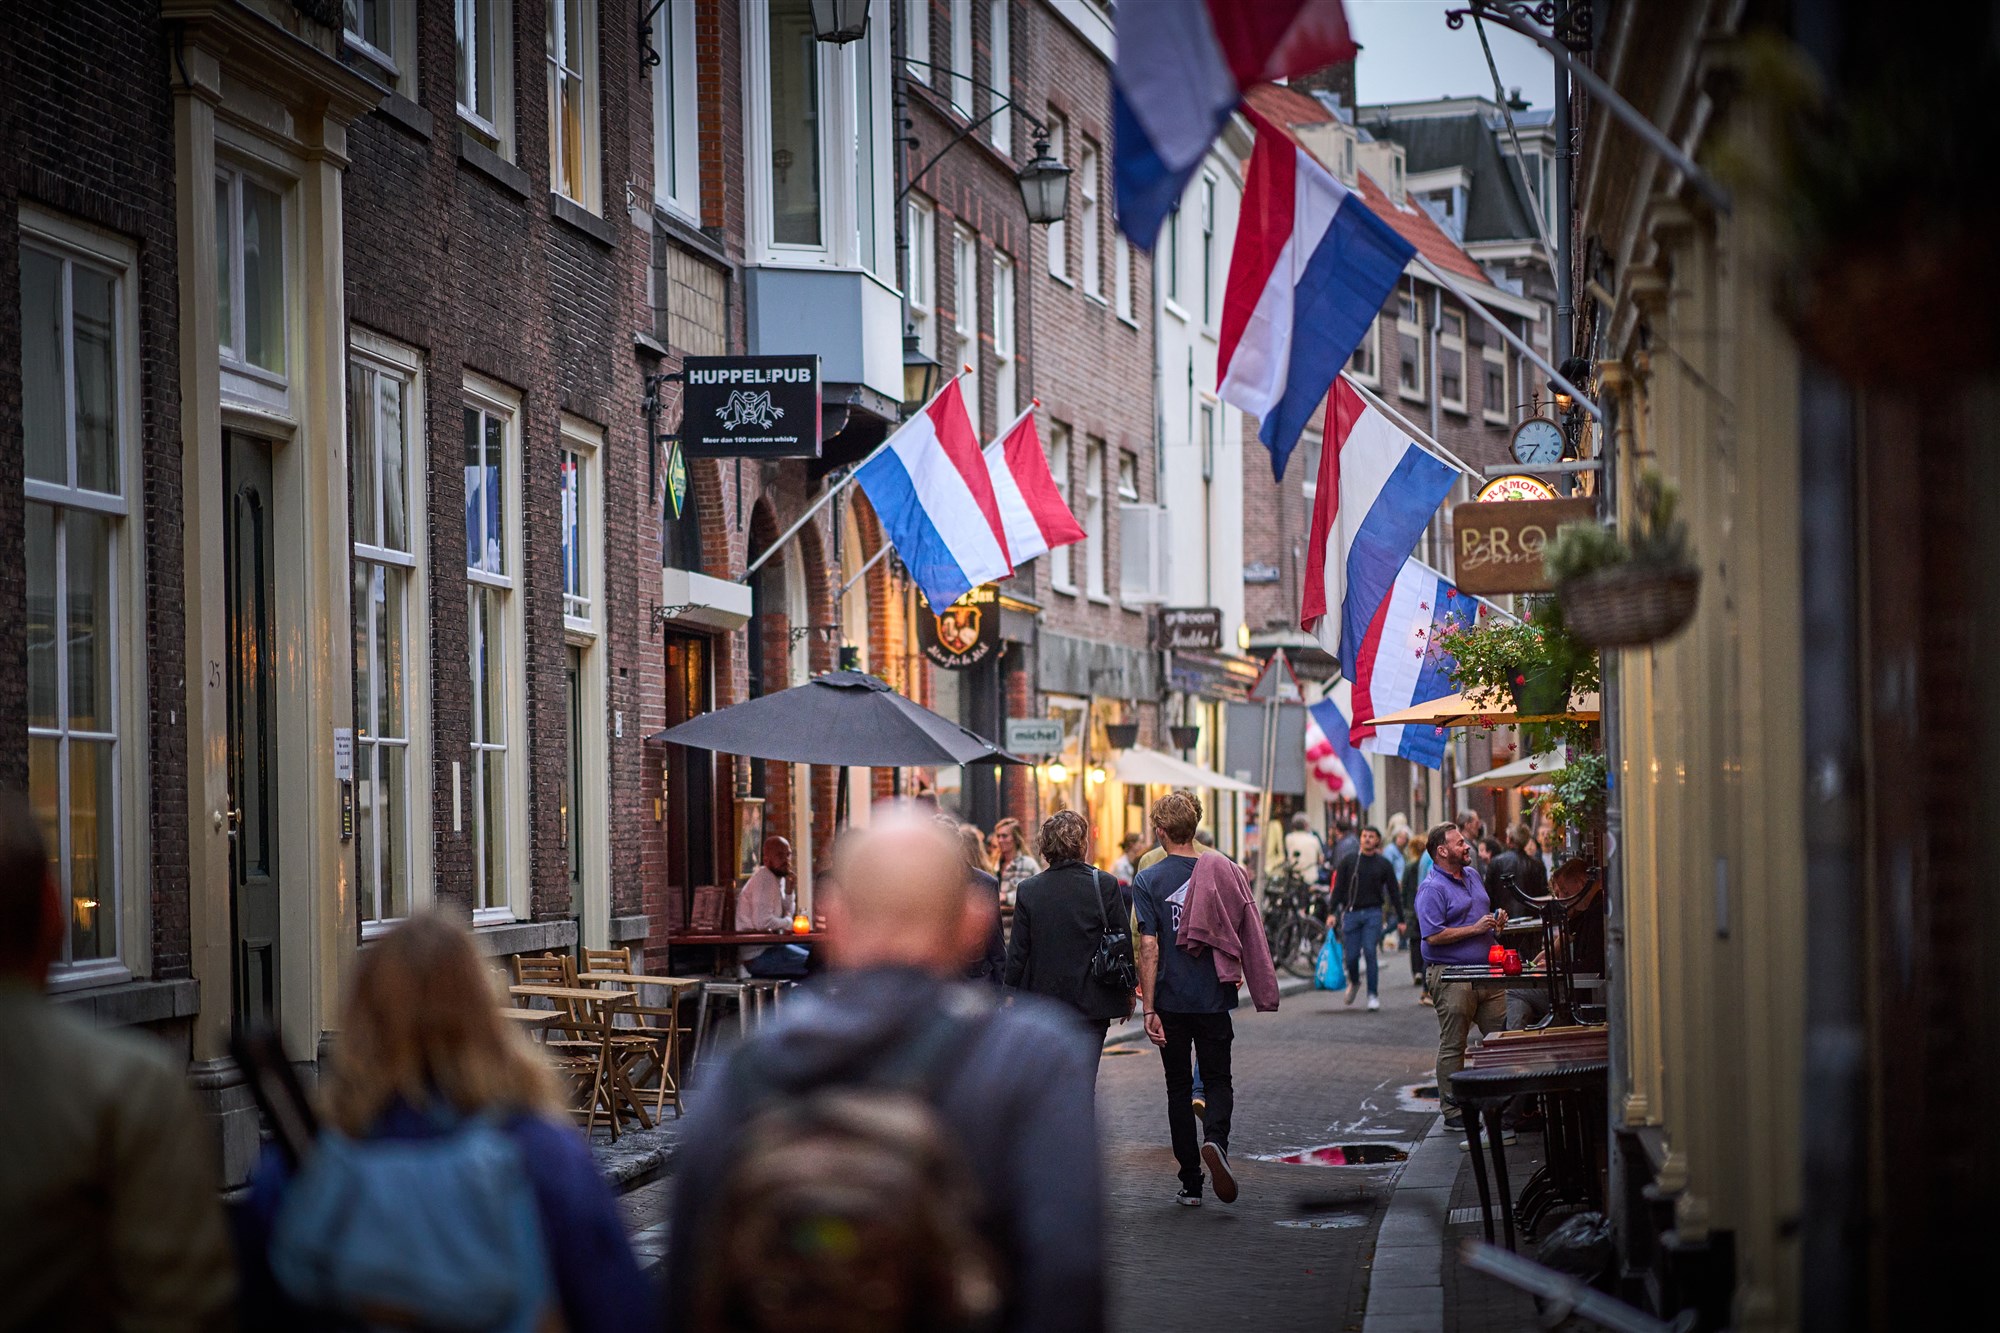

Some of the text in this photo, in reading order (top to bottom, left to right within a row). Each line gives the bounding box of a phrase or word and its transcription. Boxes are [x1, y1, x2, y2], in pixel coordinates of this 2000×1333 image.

[690, 369, 766, 384] HUPPEL
[772, 368, 811, 383] PUB
[774, 436, 798, 444] whisky
[1509, 480, 1549, 501] MORE
[1015, 729, 1057, 741] michel
